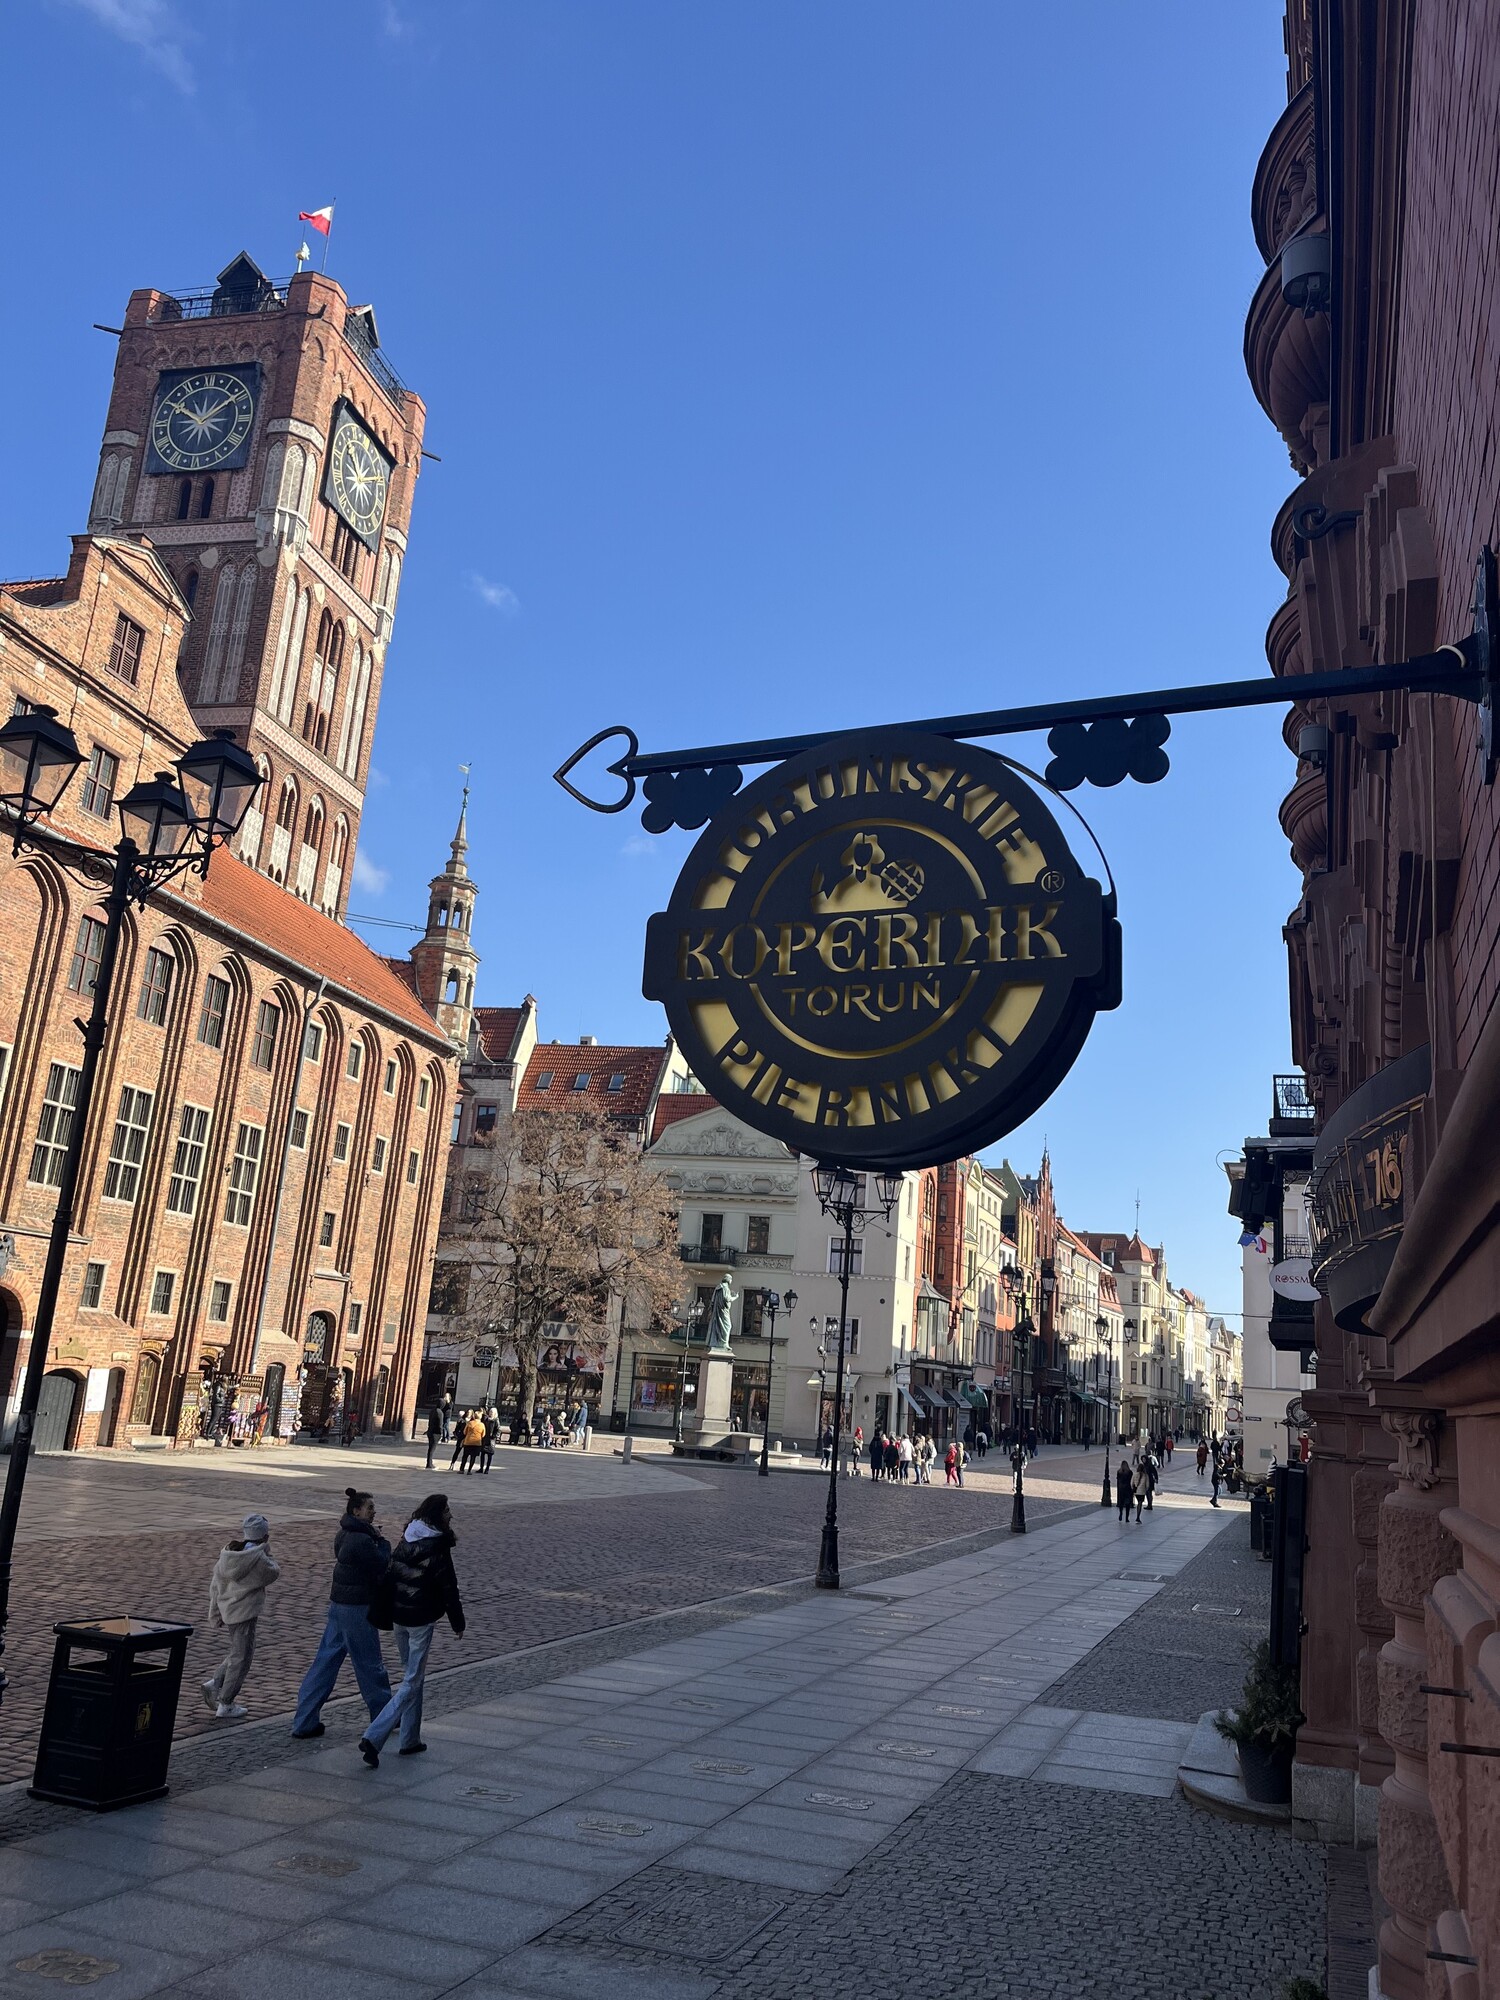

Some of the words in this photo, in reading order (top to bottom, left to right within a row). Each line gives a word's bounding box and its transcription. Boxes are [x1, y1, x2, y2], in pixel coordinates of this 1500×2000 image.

[675, 901, 1067, 981] KOPERNIK
[782, 972, 941, 1022] TORUŃ
[716, 1018, 1012, 1128] PIERNIKI
[1275, 1274, 1311, 1284] ROSSM
